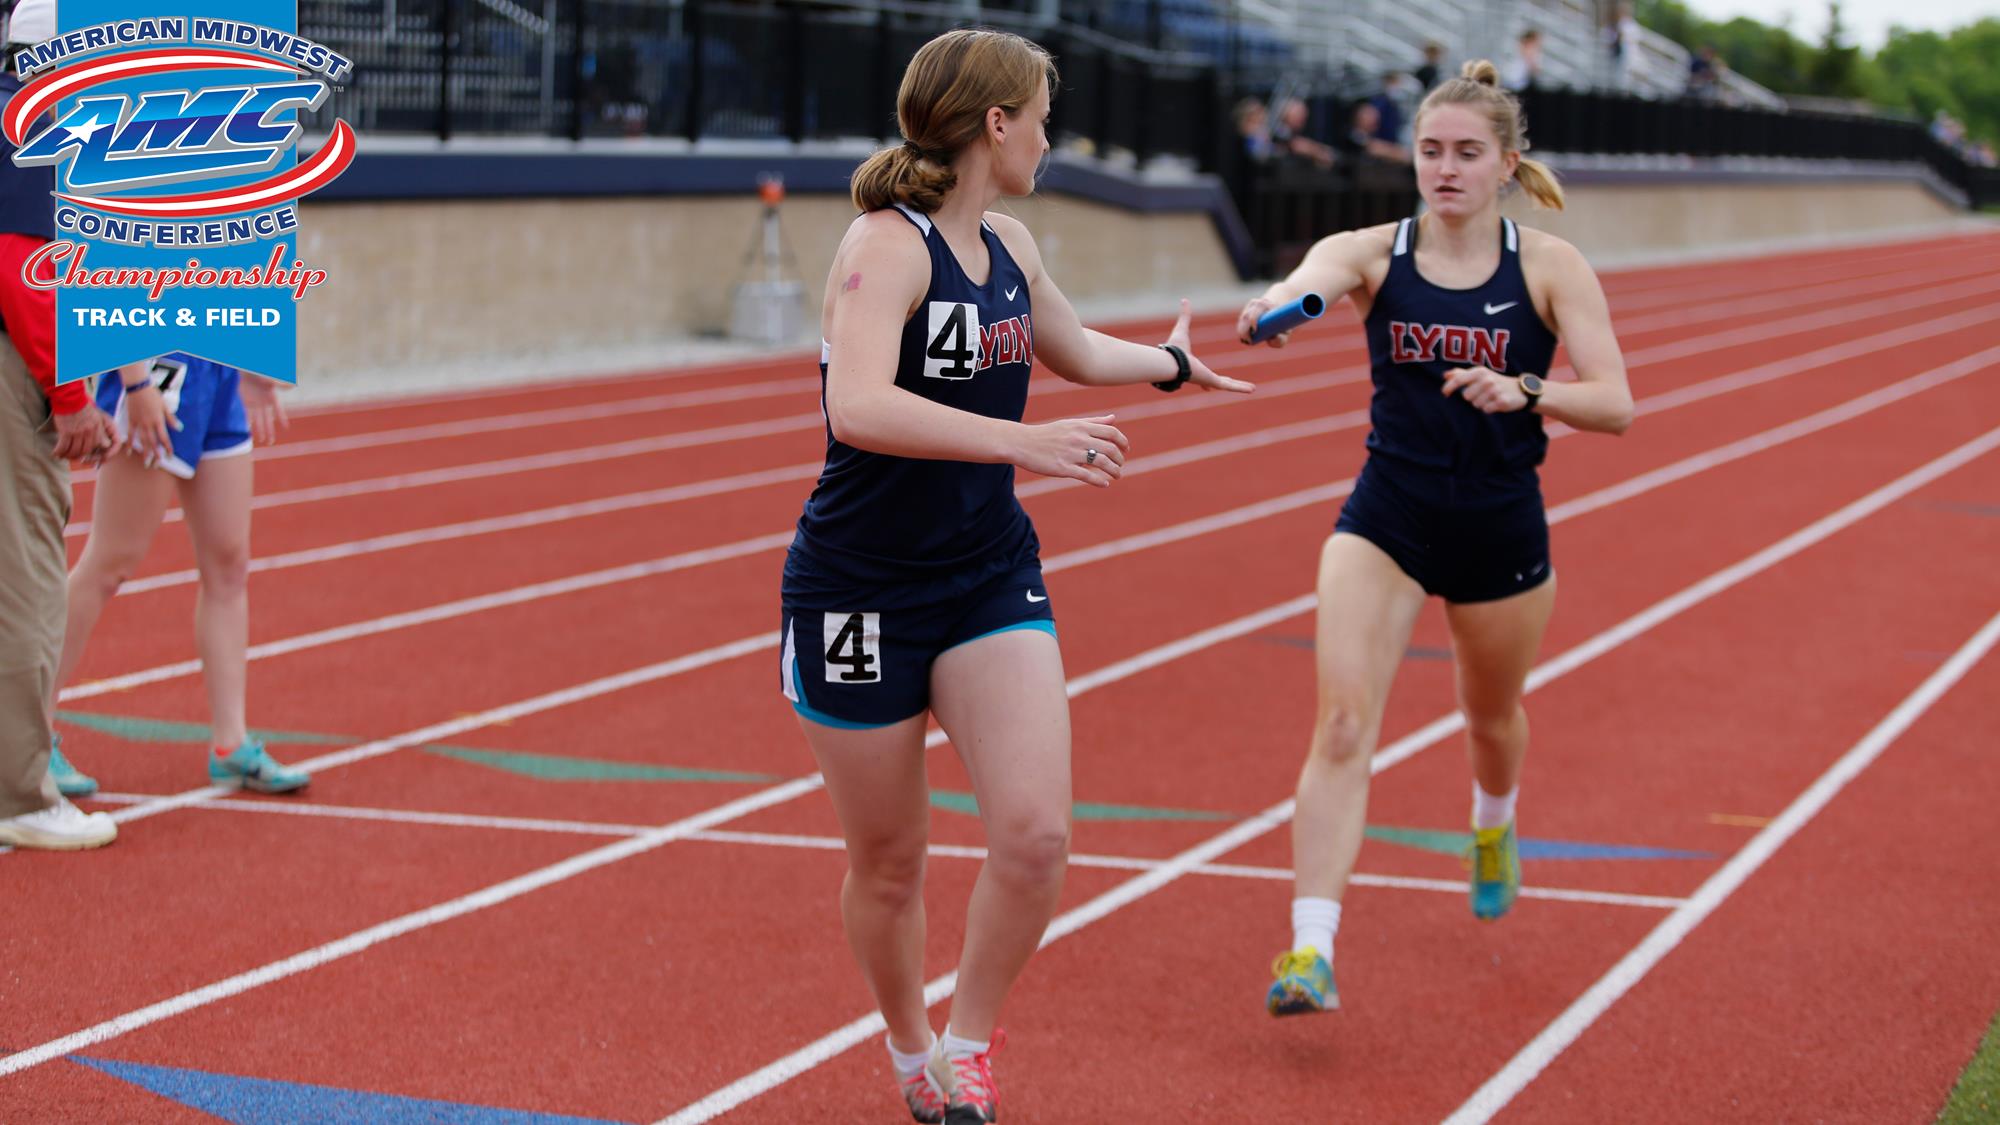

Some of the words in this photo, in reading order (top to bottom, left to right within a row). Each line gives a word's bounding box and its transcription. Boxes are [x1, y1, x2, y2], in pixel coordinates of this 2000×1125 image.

[927, 303, 974, 378] 4
[974, 313, 1033, 373] YON
[1389, 320, 1511, 373] LYON
[825, 612, 878, 681] 4
